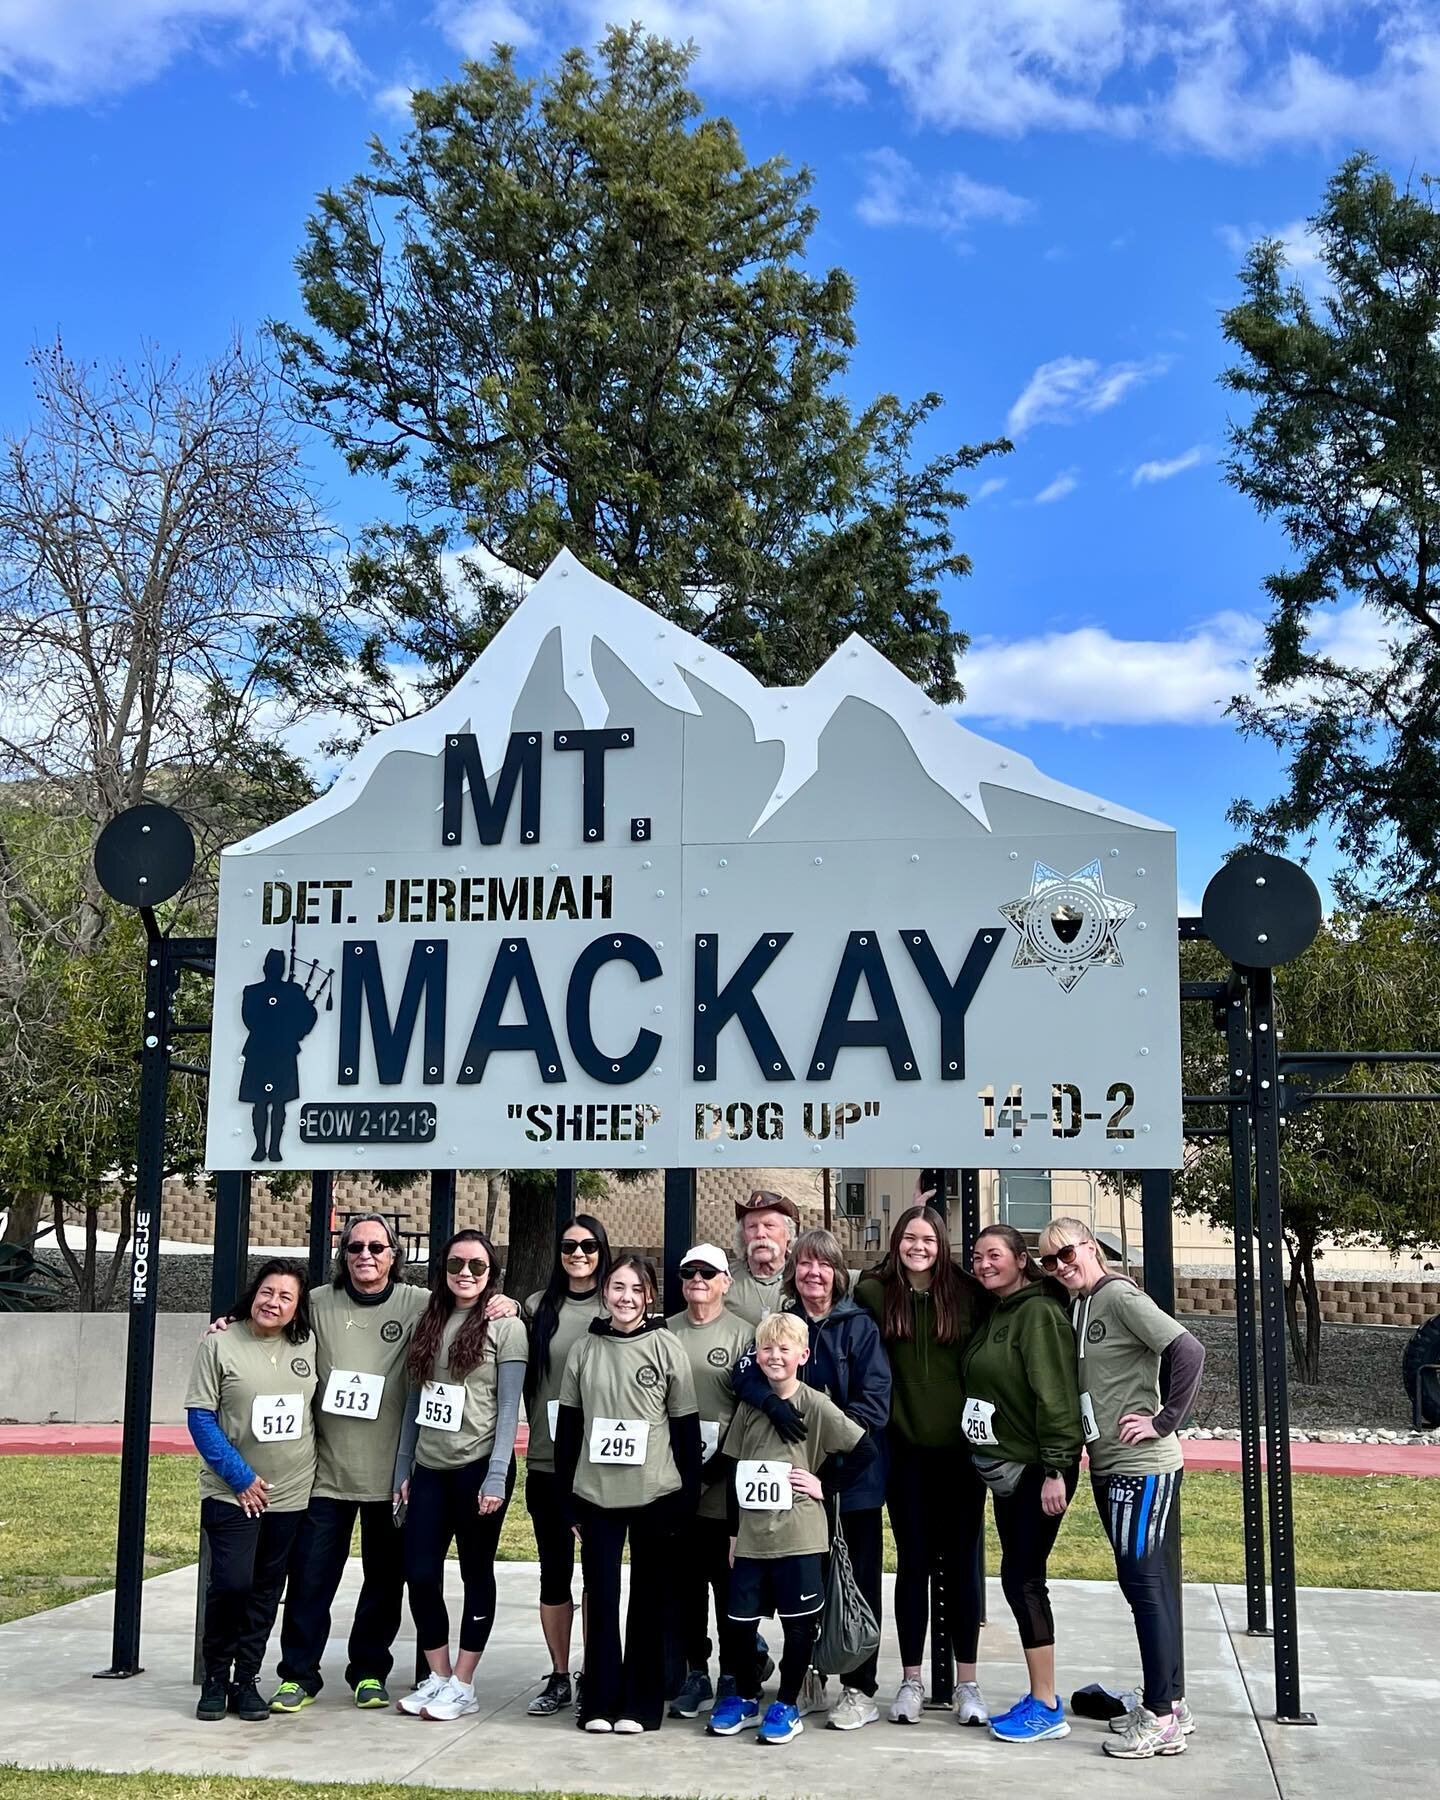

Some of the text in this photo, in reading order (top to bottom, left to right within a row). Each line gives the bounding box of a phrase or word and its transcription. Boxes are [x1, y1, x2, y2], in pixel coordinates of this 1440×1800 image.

[442, 728, 651, 845] MT.
[262, 875, 613, 925] DET. JEREMIAH
[338, 928, 1007, 1085] MACKAY
[306, 1109, 430, 1137] EOW 2-12-13
[507, 1101, 880, 1142] "SHEEP DOG UP"
[977, 1082, 1135, 1139] 14-D-2
[133, 1210, 151, 1292] ROGUE
[334, 1389, 370, 1412] 513
[425, 1400, 452, 1423] 553
[263, 1414, 295, 1435] 512
[967, 1418, 987, 1440] 259
[600, 1437, 636, 1457] 295
[745, 1481, 781, 1503] 260
